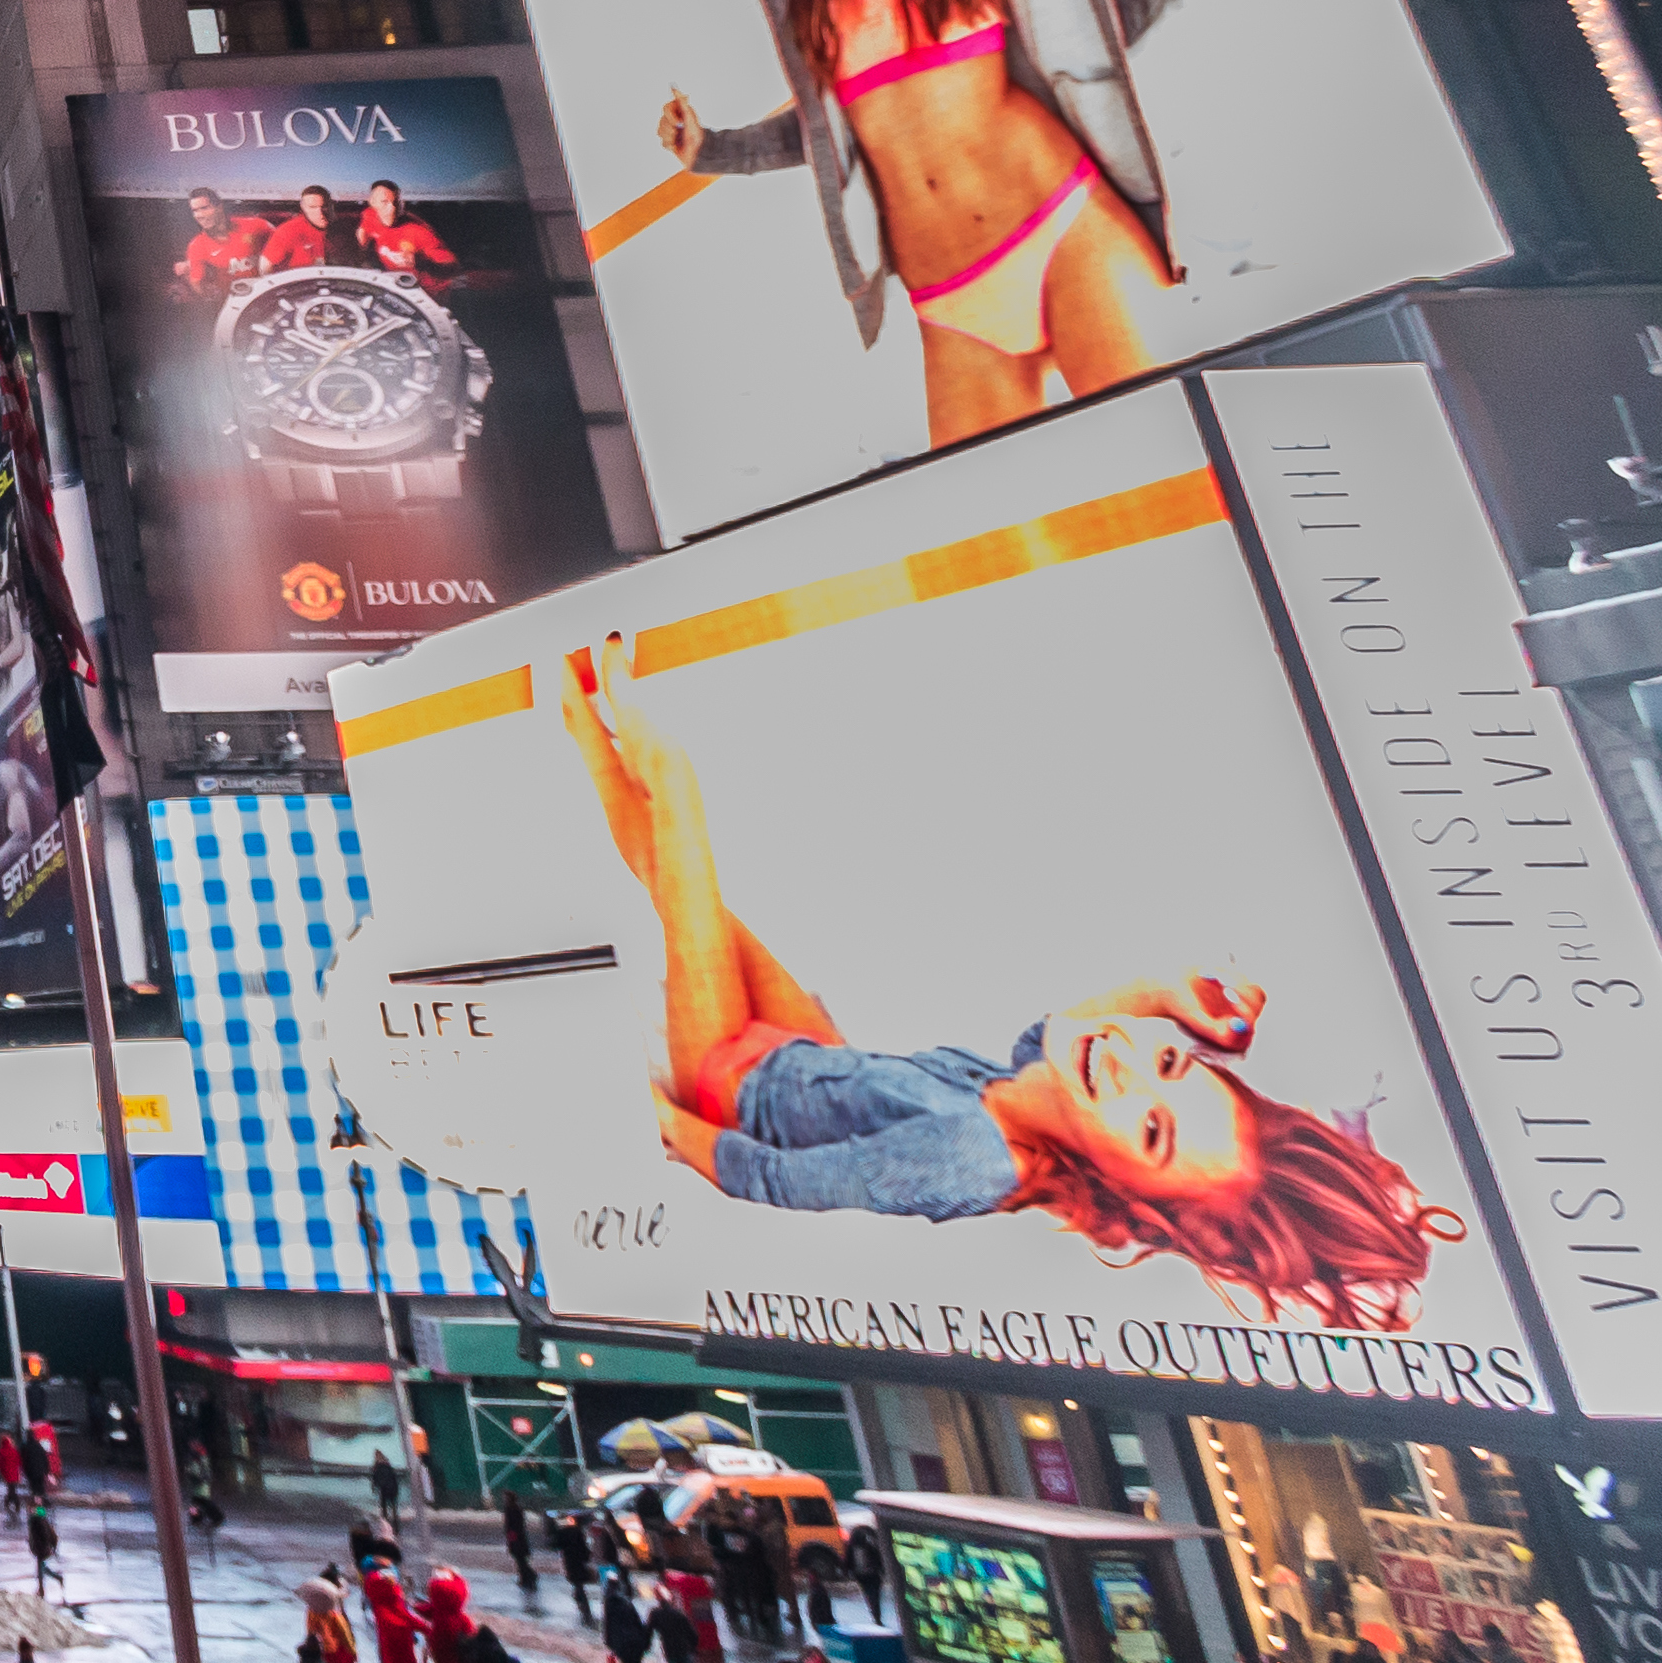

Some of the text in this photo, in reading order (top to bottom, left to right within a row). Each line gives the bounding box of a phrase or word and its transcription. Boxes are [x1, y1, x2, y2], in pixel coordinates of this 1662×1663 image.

[163, 103, 406, 153] BULOVA
[363, 580, 497, 607] BULOVA
[1321, 576, 1407, 653] ON
[1364, 697, 1515, 927] INSIDE
[1457, 683, 1589, 868] LEVEL
[380, 1001, 494, 1038] LIFE
[1470, 974, 1564, 1060] US
[574, 1201, 670, 1252] aerie
[1515, 1106, 1660, 1313] VISIT
[702, 1289, 1540, 1408] AMERICAN EAGLE OUTFITTERS
